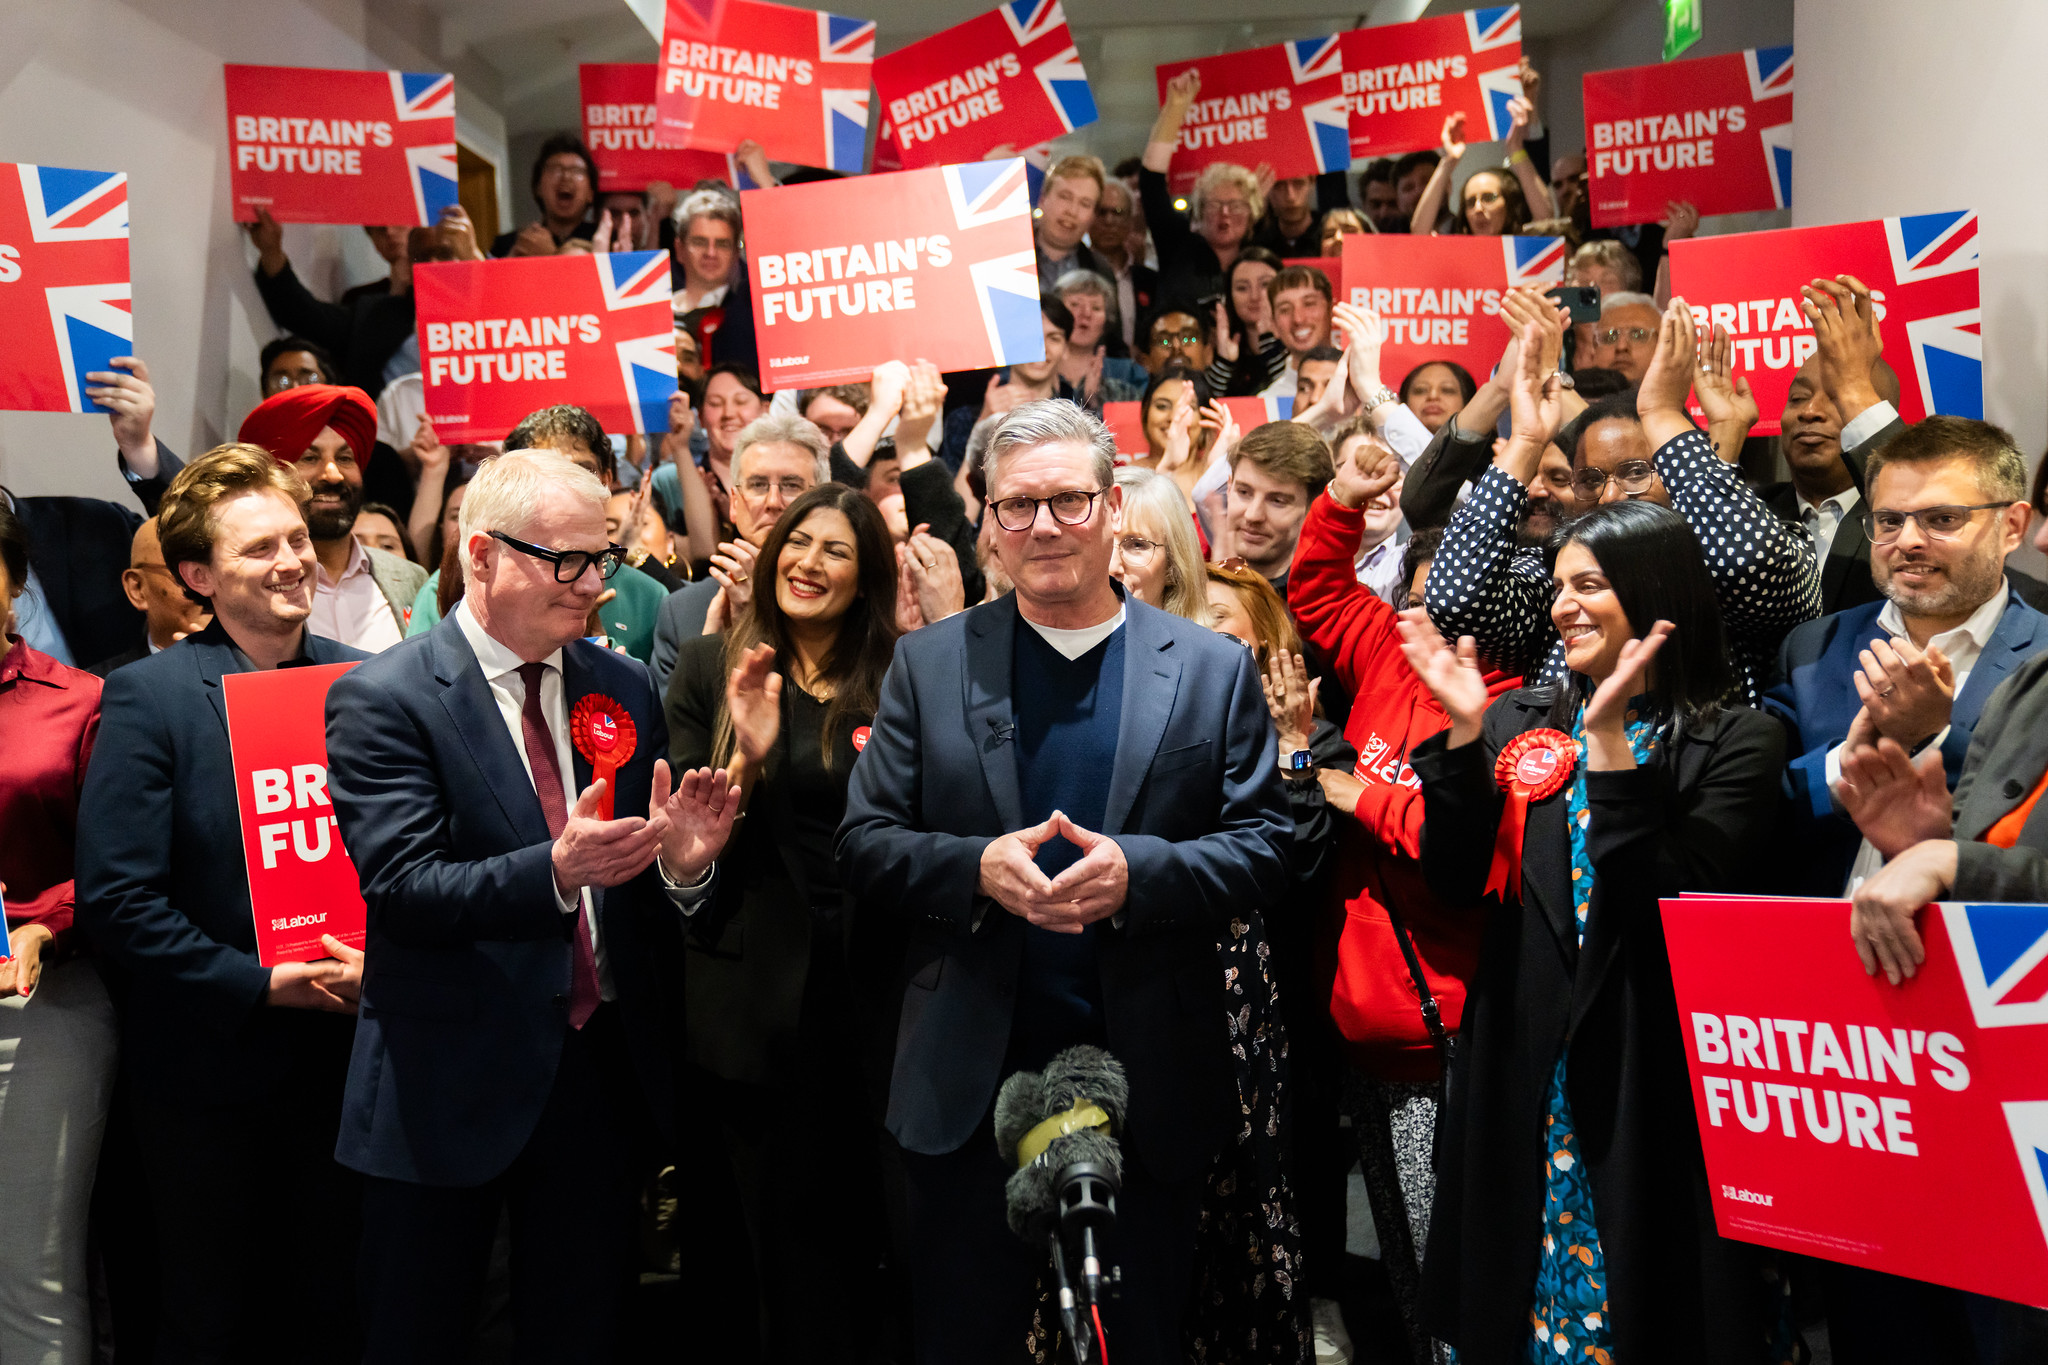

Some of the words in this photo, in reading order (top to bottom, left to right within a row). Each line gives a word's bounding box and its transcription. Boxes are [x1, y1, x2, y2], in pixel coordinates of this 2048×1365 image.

[668, 38, 814, 86] BRITAIN'S
[1341, 54, 1468, 96] BRITAIN'S
[665, 67, 782, 110] FUTURE
[889, 52, 1022, 124] BRITAIN'S
[1185, 87, 1292, 126] RITAIN'S
[235, 114, 393, 147] BRITAIN'S
[587, 104, 657, 126] BRITA
[898, 87, 1004, 150] FUTURE
[1593, 105, 1747, 149] BRITAIN'S
[589, 129, 686, 150] FUTU
[1595, 138, 1715, 178] FUTURE
[237, 144, 362, 175] FUTURE
[758, 234, 953, 289] BRITAIN'S
[762, 276, 917, 326] FUTURE
[1350, 287, 1501, 315] BRITAIN'S
[426, 314, 602, 352] BRITAIN'S
[429, 350, 567, 386] FUTURE
[593, 728, 614, 740] Labour
[283, 912, 327, 930] Labour
[1691, 1012, 1971, 1092] BRITAIN'S
[1702, 1075, 1919, 1157] FUTURE
[1733, 1186, 1774, 1207] Labour
